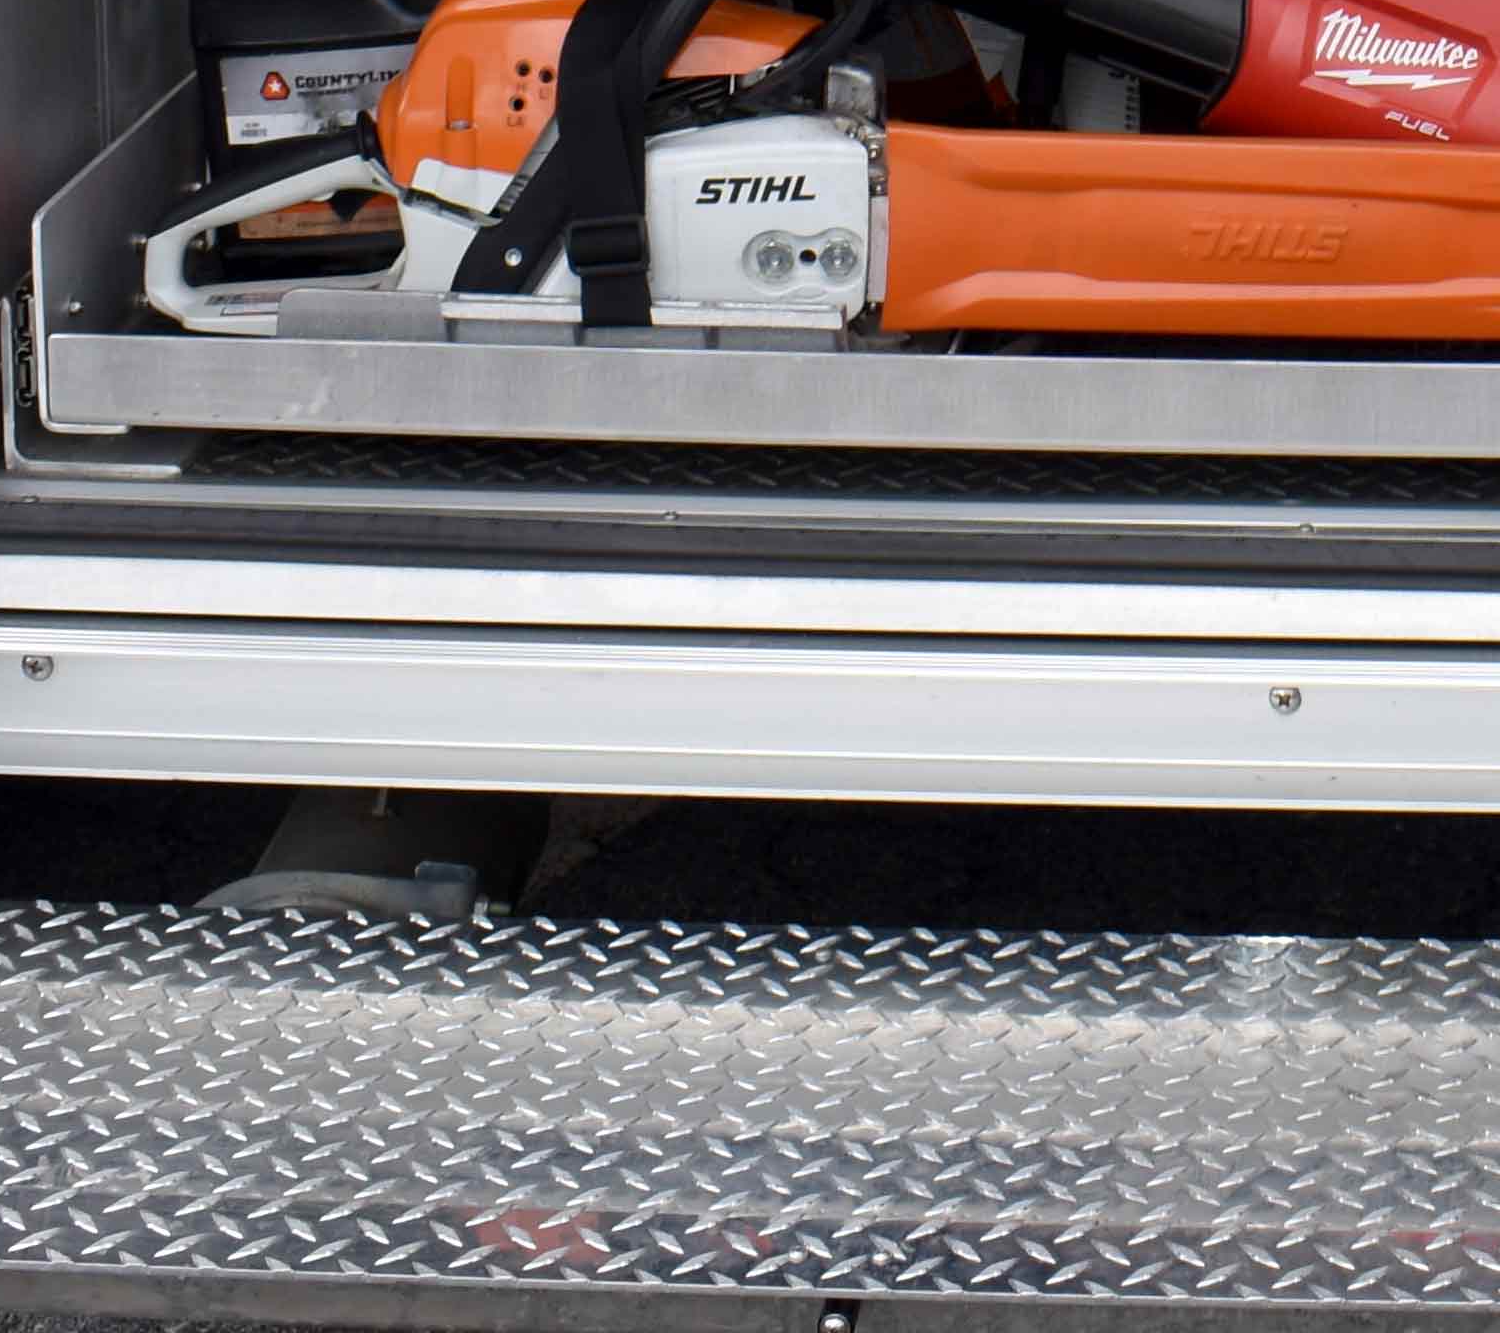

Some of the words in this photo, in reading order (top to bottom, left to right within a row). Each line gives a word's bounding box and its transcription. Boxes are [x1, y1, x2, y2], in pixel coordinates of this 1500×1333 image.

[1315, 7, 1479, 71] Milwaukee
[1384, 110, 1451, 141] FUEL
[695, 175, 816, 204] STIHL
[1189, 222, 1348, 262] STIHL
